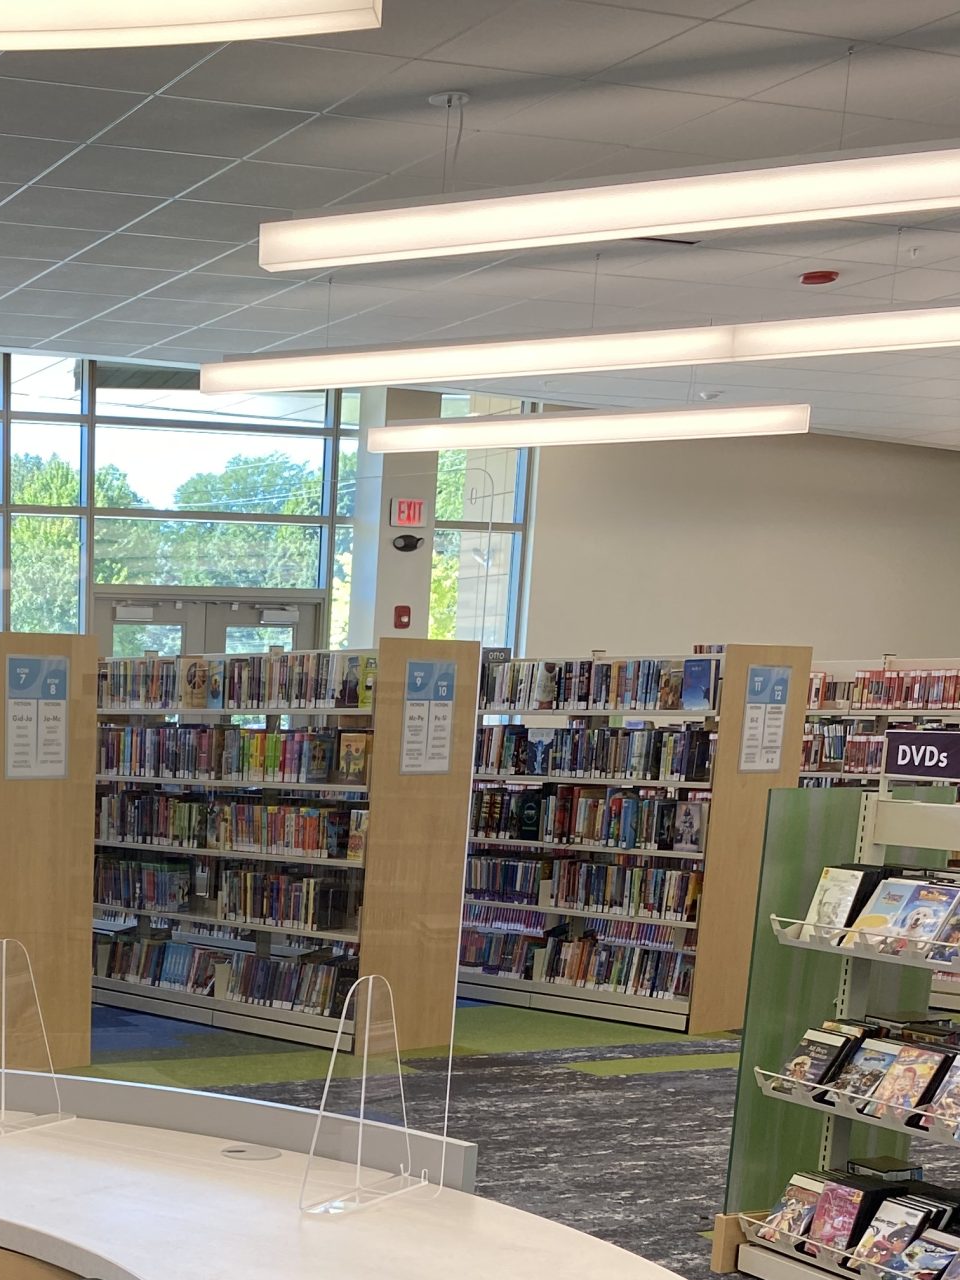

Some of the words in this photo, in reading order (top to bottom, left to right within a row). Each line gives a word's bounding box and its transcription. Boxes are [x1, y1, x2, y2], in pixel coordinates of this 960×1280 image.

[398, 500, 424, 523] EXIT
[20, 674, 27, 684] 7
[416, 677, 422, 687] 9
[50, 685, 56, 695] 8
[439, 686, 447, 696] 10
[755, 682, 761, 691] 11
[775, 691, 782, 700] 12
[897, 744, 948, 768] DVDs
